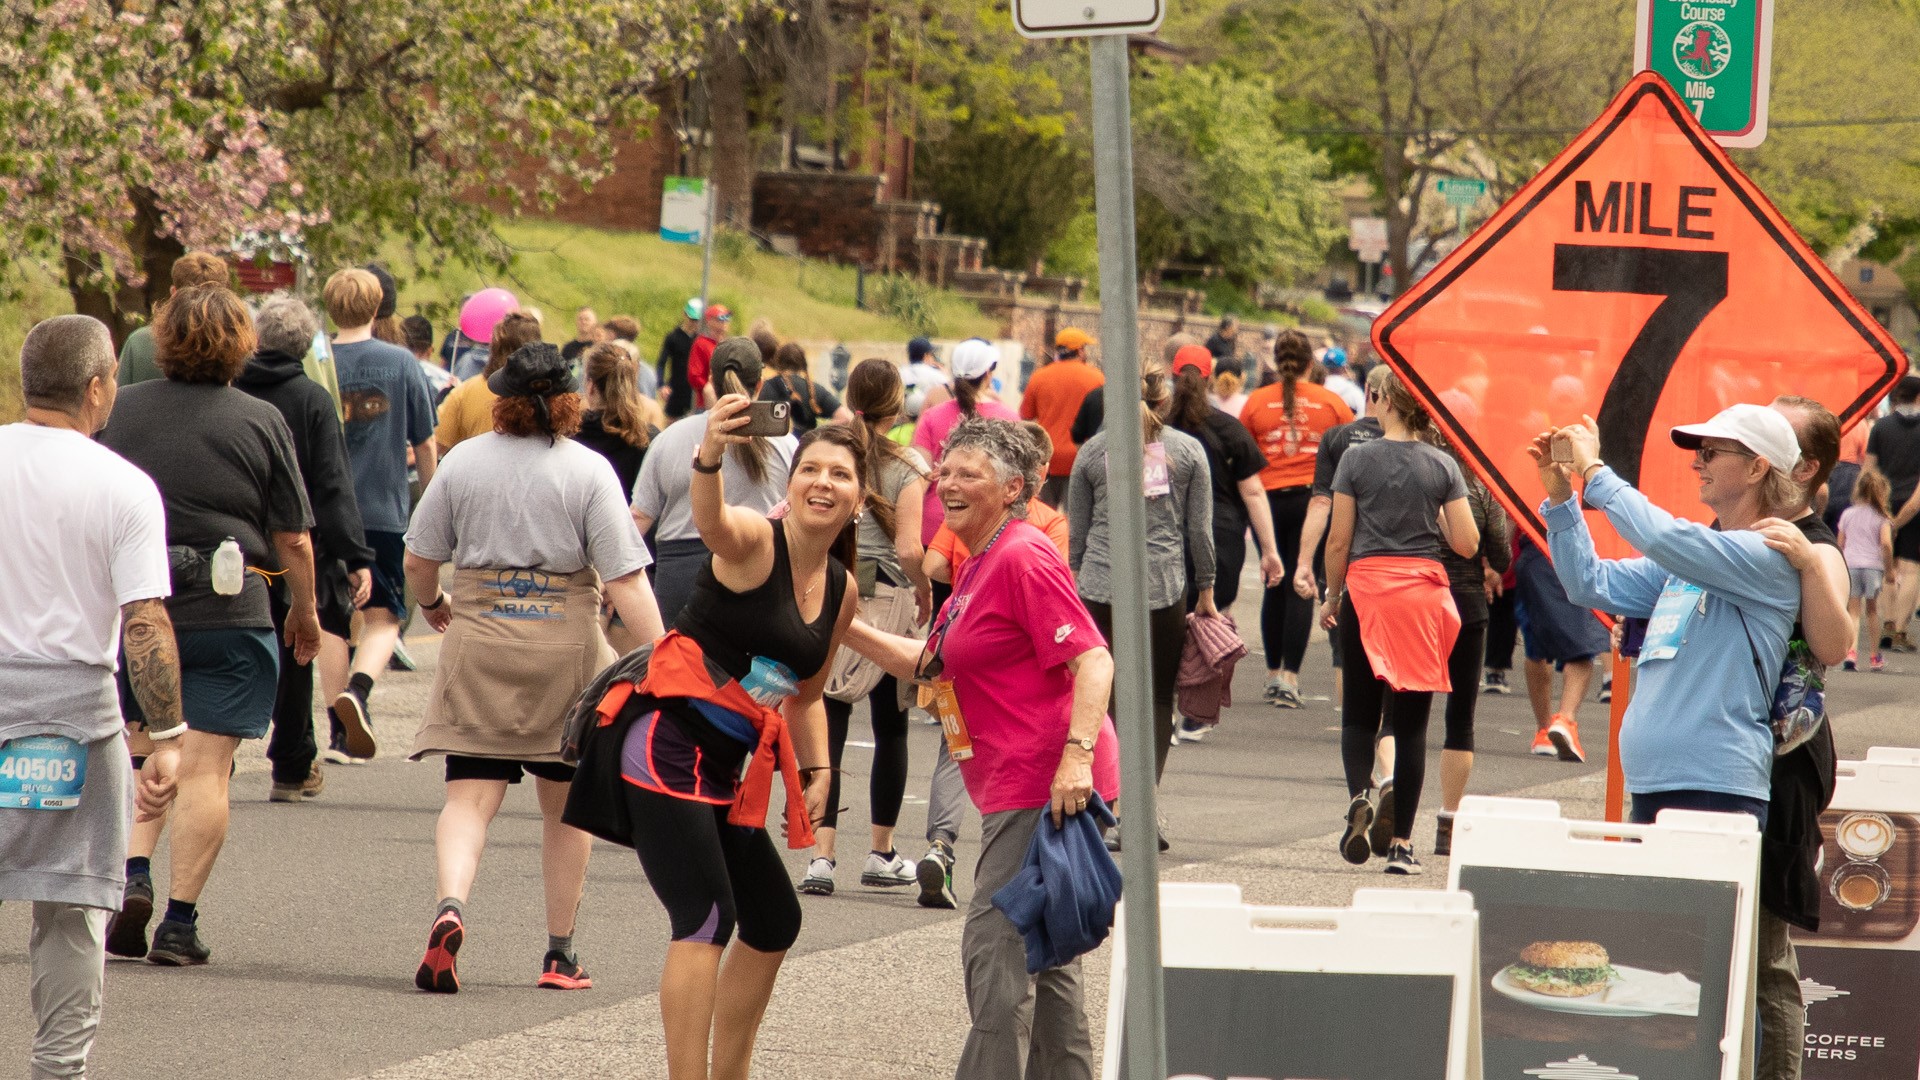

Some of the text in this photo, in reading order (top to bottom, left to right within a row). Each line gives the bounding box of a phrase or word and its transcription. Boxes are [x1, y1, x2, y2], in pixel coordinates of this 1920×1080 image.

[1681, 2, 1726, 21] Course
[1685, 81, 1715, 99] Mile
[1692, 100, 1704, 122] 7
[1574, 180, 1717, 240] MILE
[1552, 243, 1729, 510] 7
[492, 604, 553, 615] ARIAT
[0, 756, 76, 782] 40503
[21, 783, 54, 793] BUYEA
[1805, 1033, 1885, 1048] COFFEE
[1804, 1047, 1857, 1061] TERS
